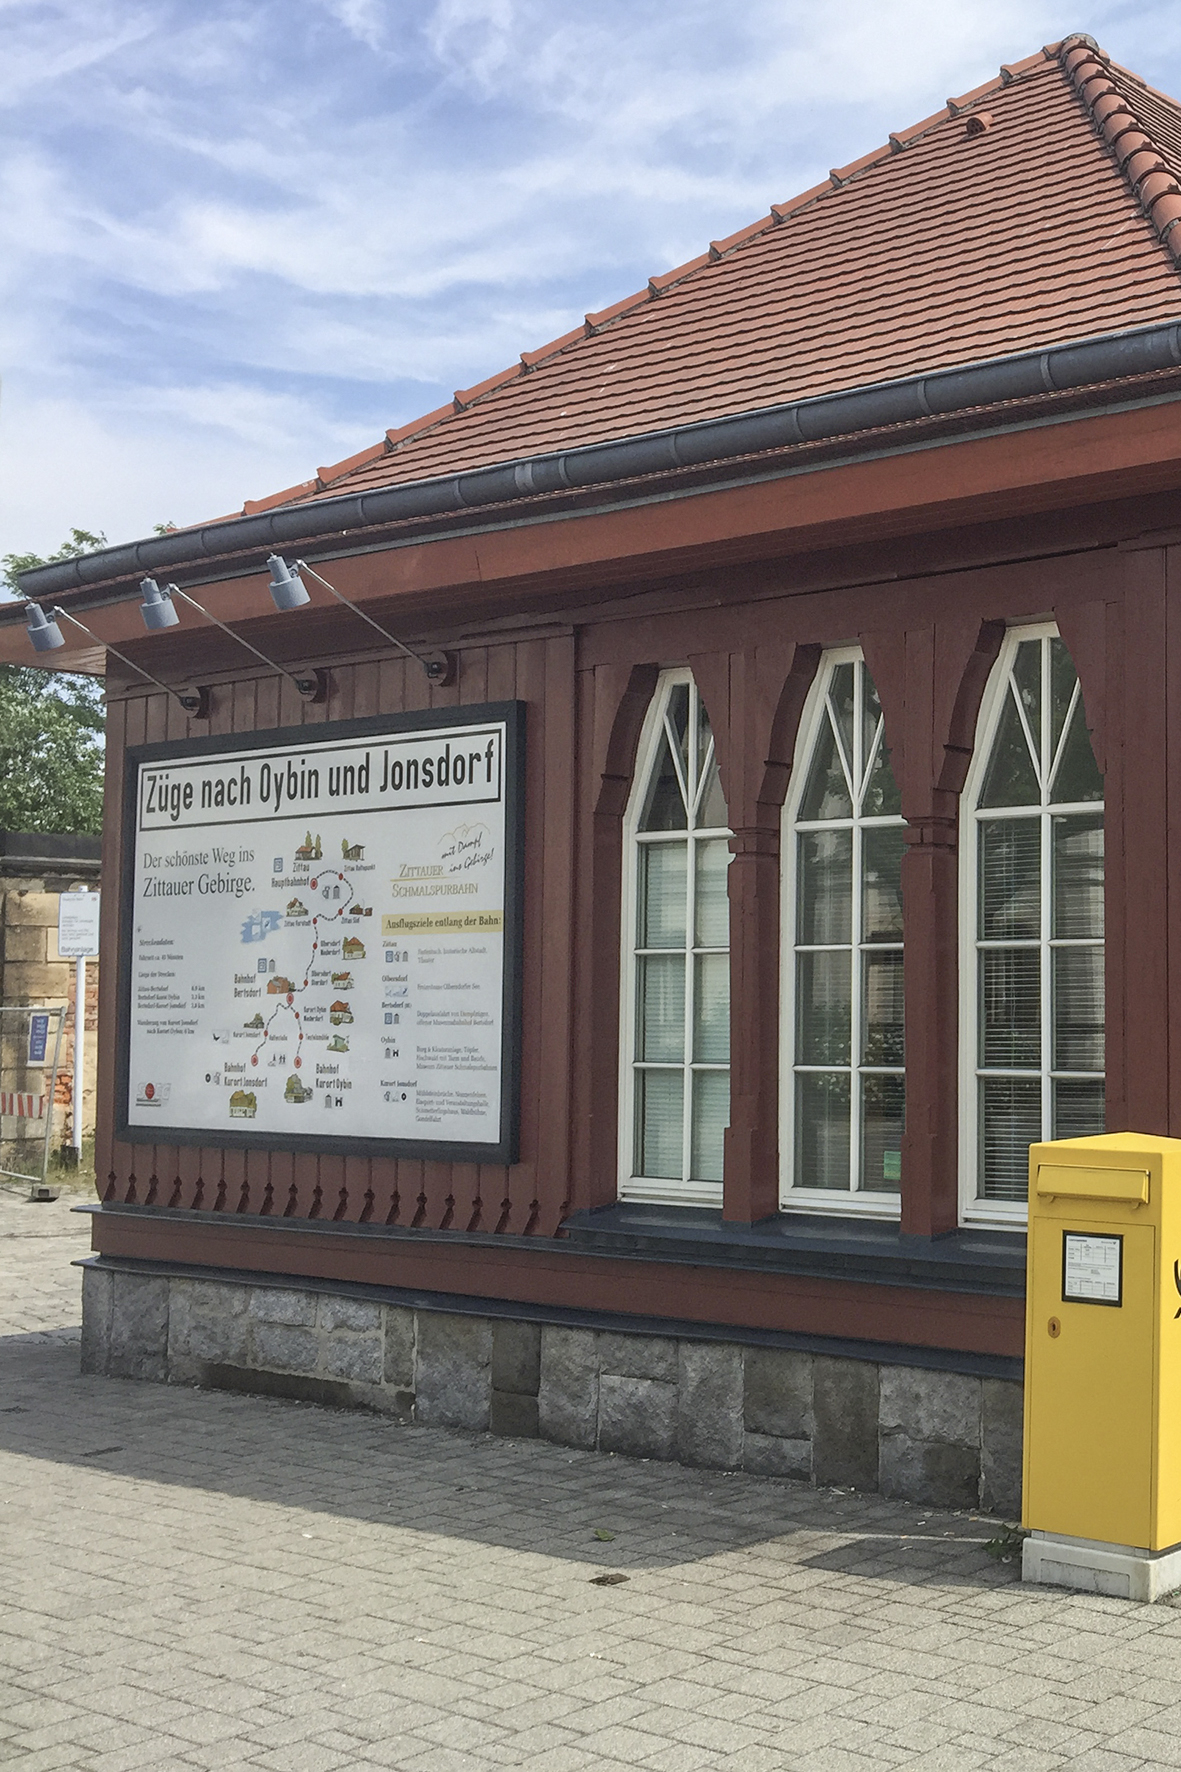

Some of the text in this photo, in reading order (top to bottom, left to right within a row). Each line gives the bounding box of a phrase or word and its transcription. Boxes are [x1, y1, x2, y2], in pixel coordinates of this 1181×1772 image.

[146, 739, 494, 821] Züge nach Oybin und Jonsdorf
[143, 846, 255, 868] Der schönste Weg ins
[293, 862, 310, 873] Zittau
[143, 872, 255, 898] Zittauer Gebirge.
[271, 876, 310, 889] Hauptbahnhof
[386, 915, 501, 930] Ausflugsziele entlang der Bahn:
[234, 973, 256, 984] Bahnhof
[234, 987, 262, 998] Bertsdorf
[381, 1001, 404, 1009] Bertsdorf
[224, 1062, 246, 1073] Bahnhof
[316, 1063, 339, 1074] Bahnhof
[224, 1076, 268, 1087] Kurort Jonsdorf
[316, 1078, 352, 1091] Kurort Oybin
